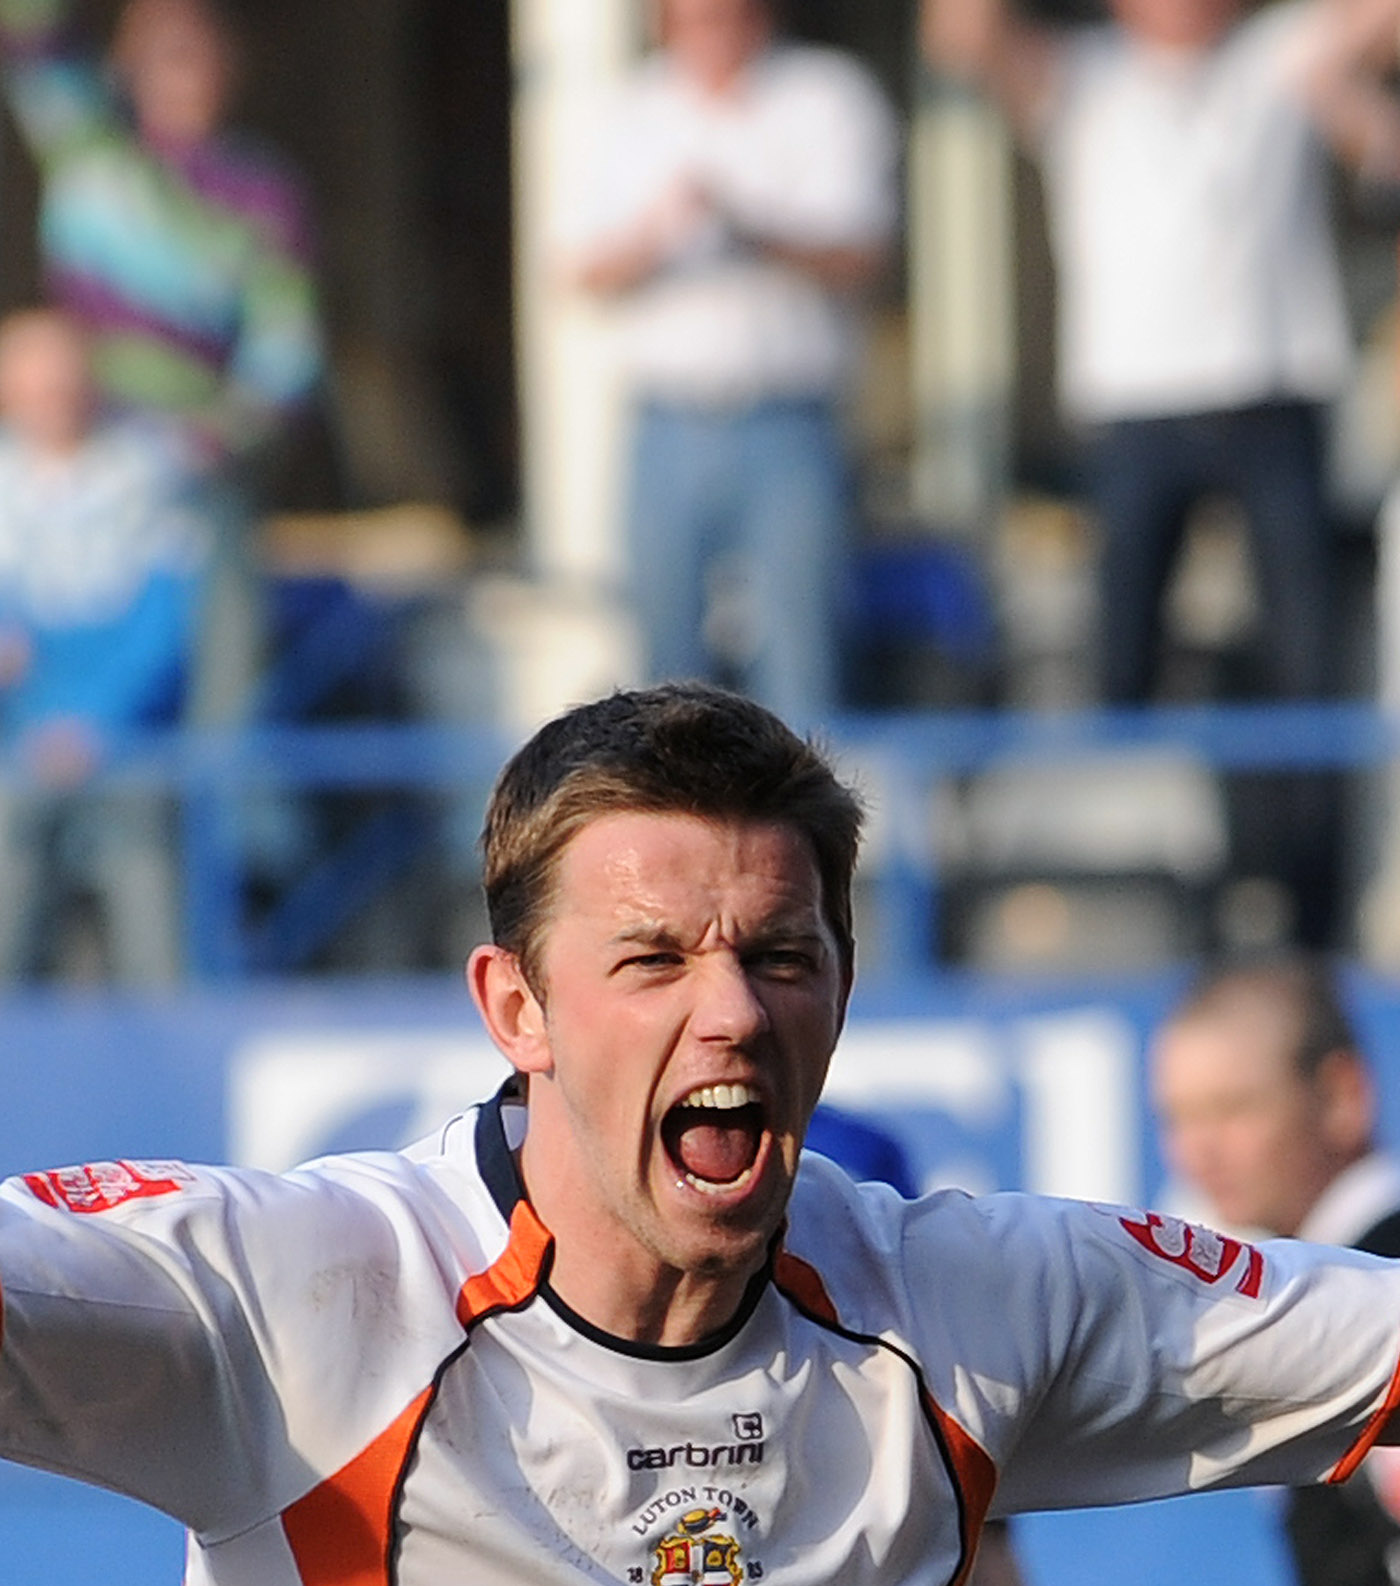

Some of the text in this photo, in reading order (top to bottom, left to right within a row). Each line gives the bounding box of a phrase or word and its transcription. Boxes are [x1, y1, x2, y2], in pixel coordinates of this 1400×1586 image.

[627, 1442, 764, 1471] carbrini
[632, 1486, 760, 1536] LUTON TOWN
